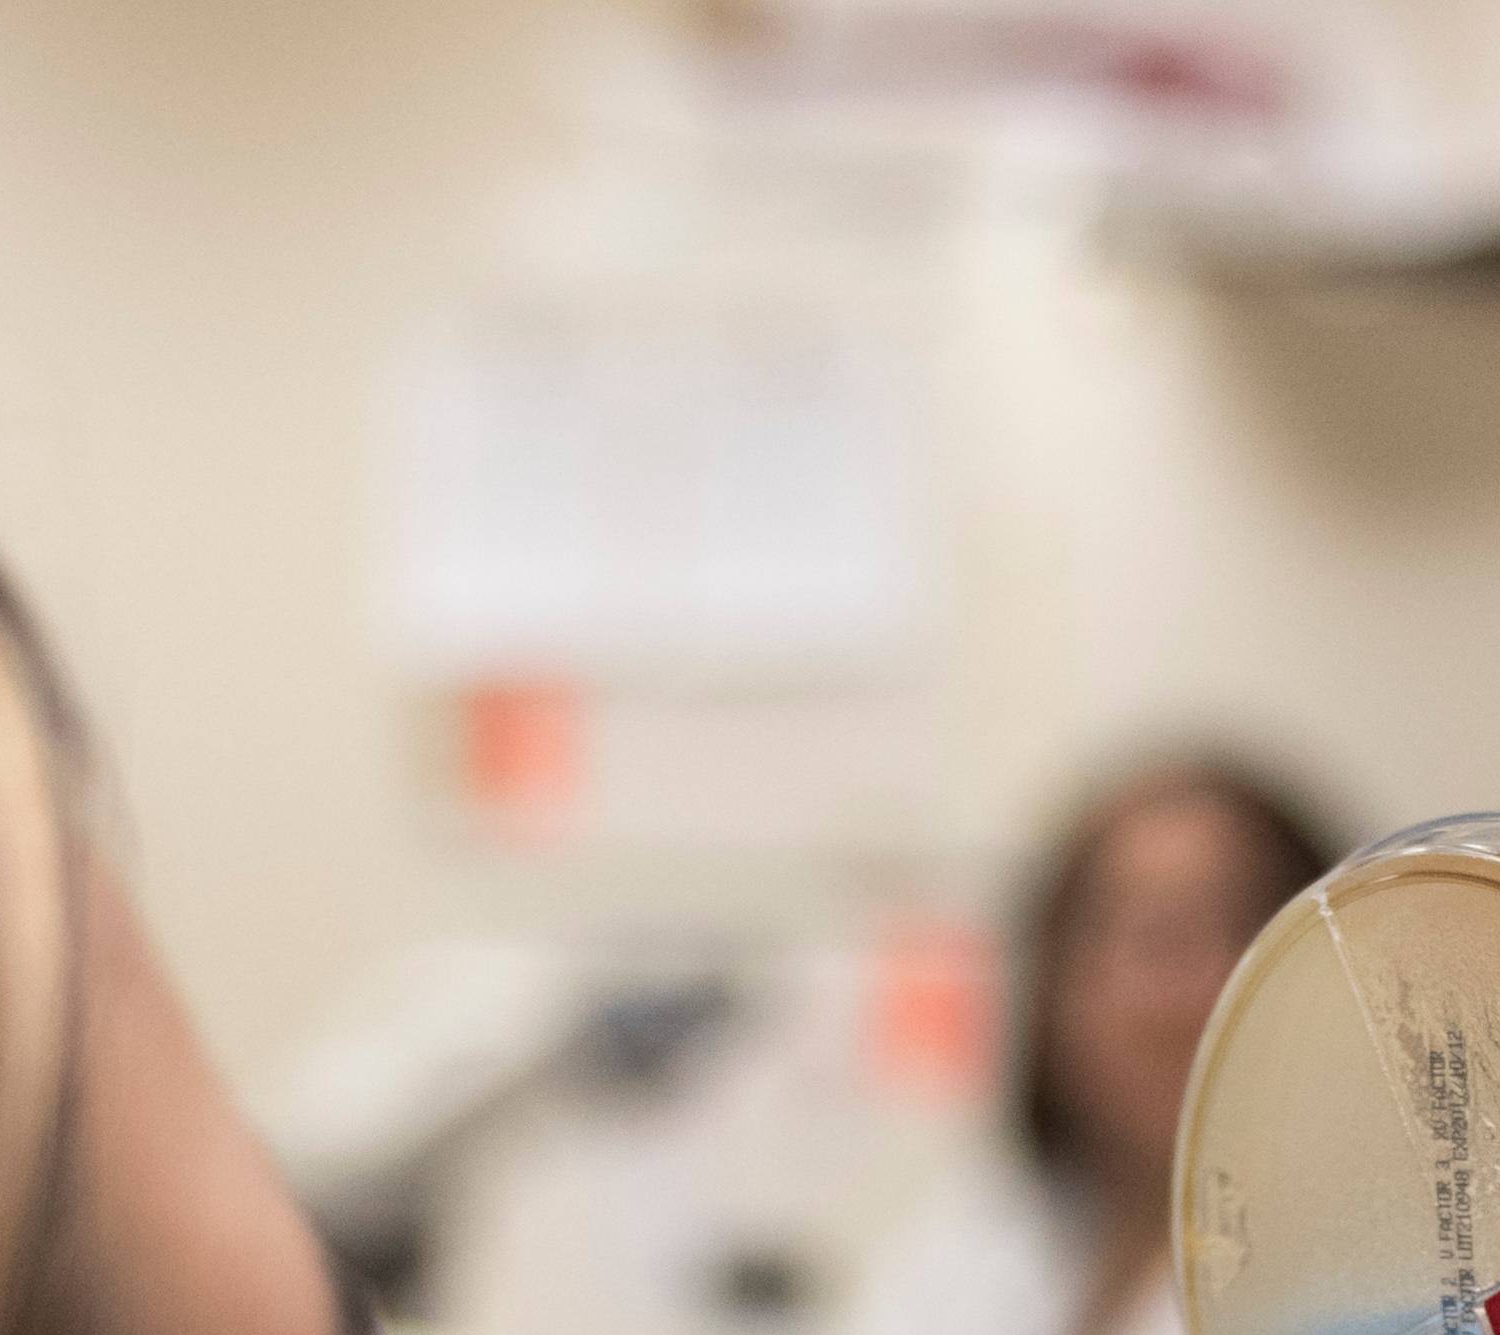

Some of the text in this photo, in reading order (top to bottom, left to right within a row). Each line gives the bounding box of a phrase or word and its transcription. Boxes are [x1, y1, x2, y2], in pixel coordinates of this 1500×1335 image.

[1429, 1051, 1447, 1110] FACTOR
[1436, 1160, 1450, 1169] 3
[1436, 1181, 1453, 1241] FACTOR
[1441, 1277, 1454, 1287] 2
